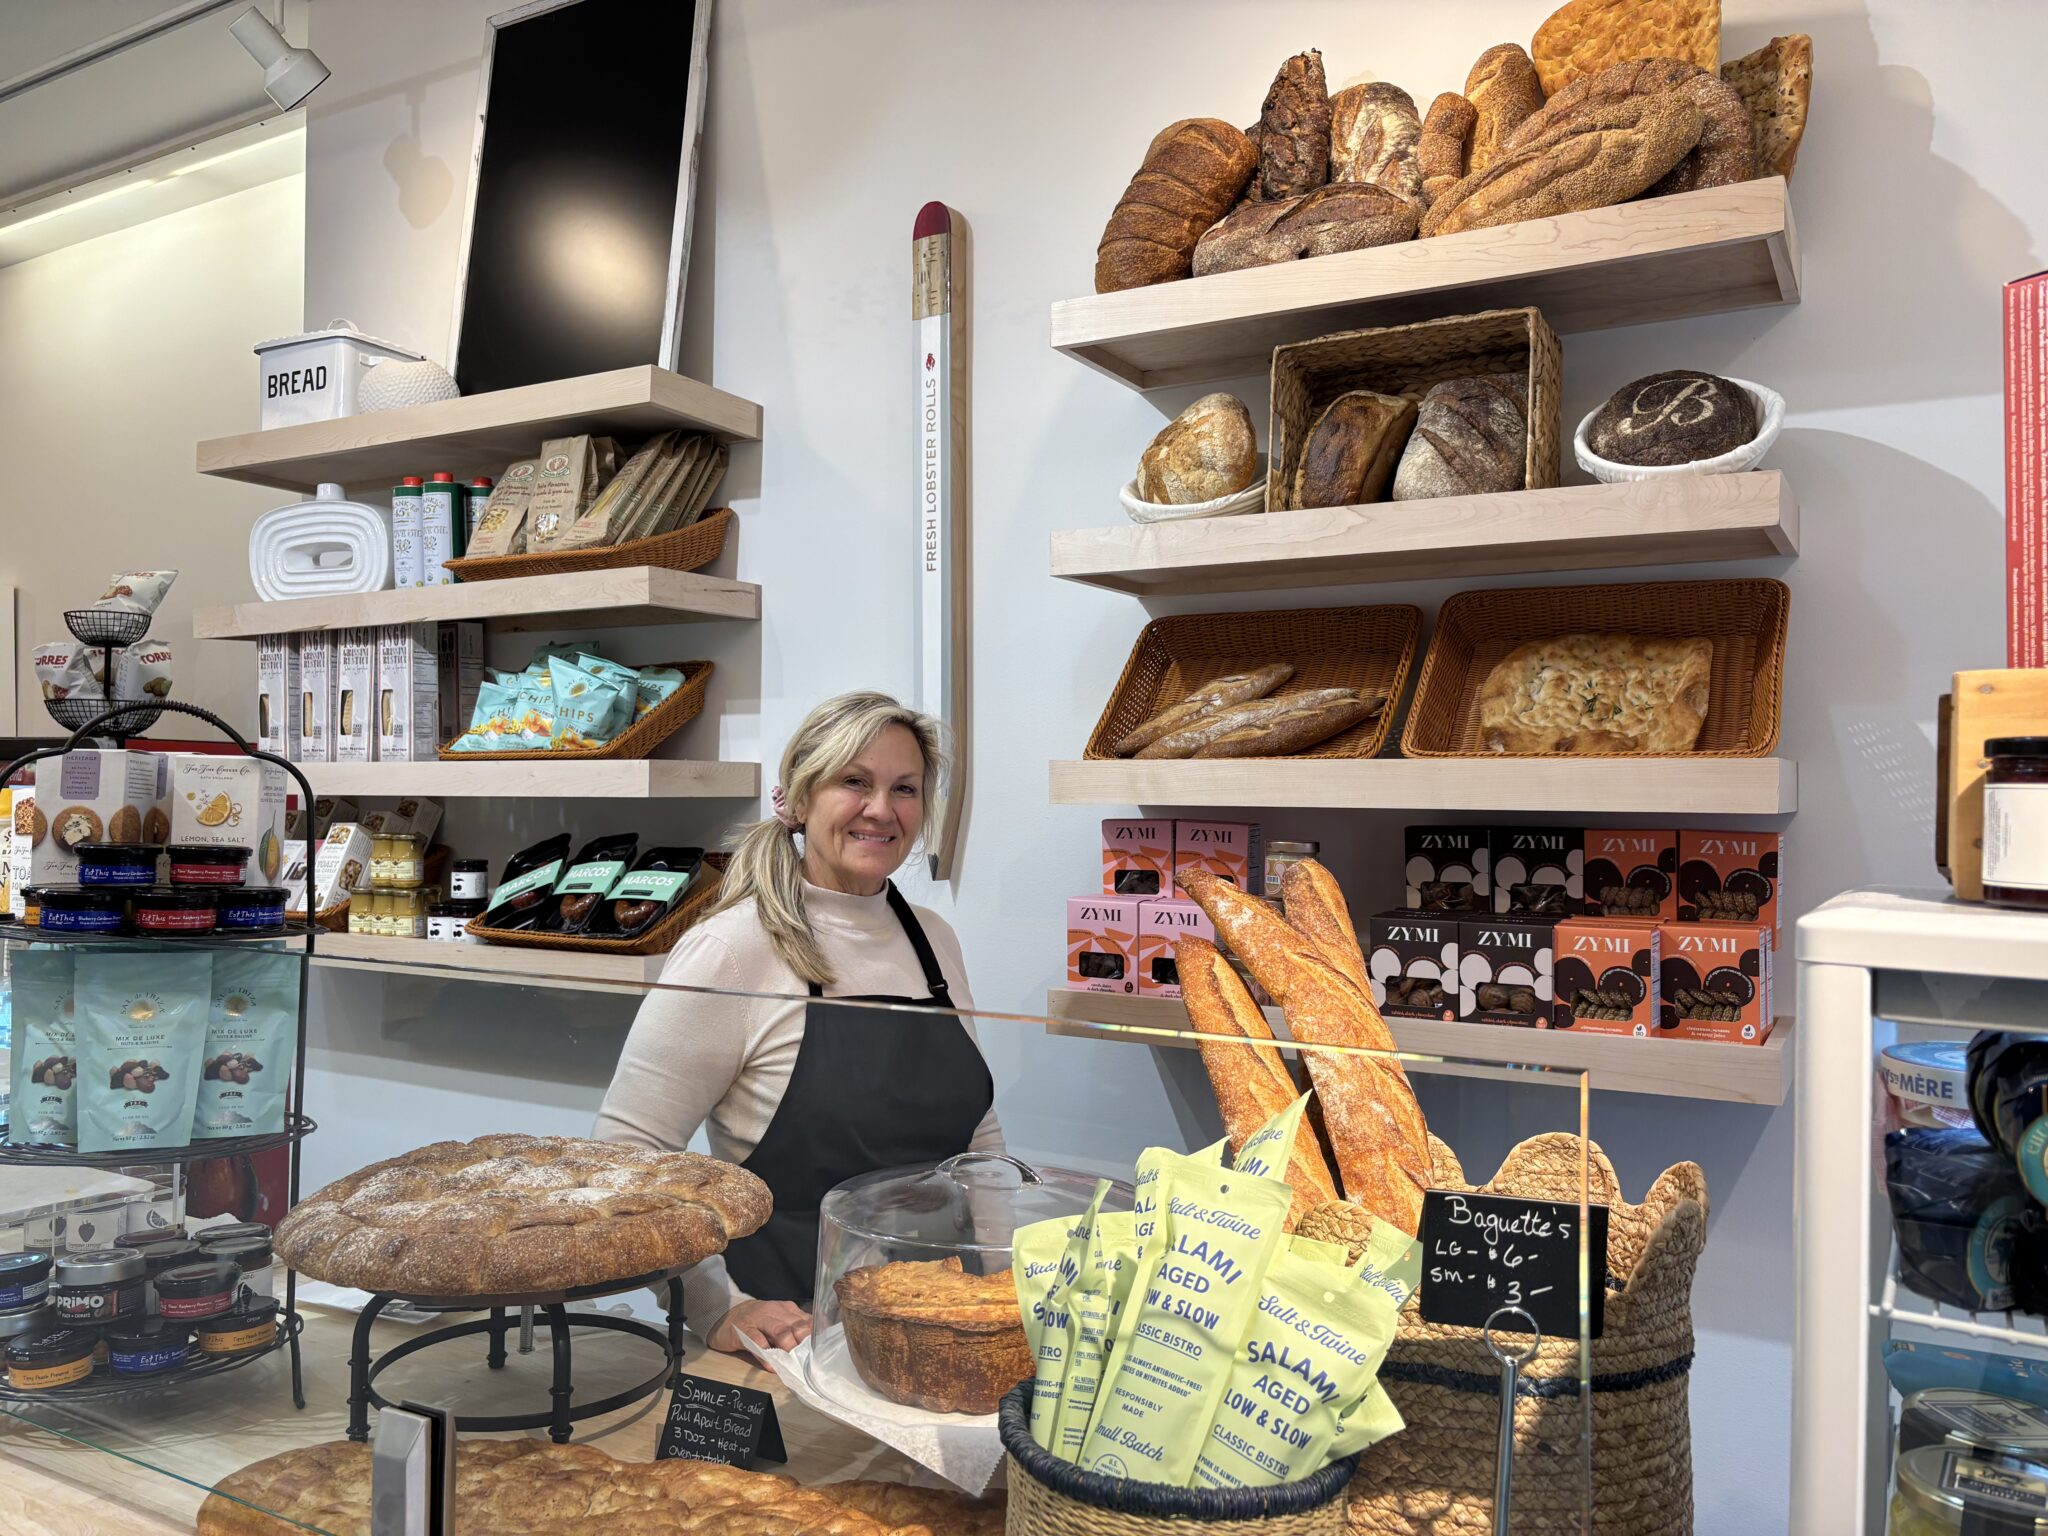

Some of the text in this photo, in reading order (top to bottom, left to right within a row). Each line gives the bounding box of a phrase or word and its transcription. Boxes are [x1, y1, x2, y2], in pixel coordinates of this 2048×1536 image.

[267, 365, 328, 399] BREAD
[925, 378, 937, 572] FRESH LOBSTER ROLLS
[519, 691, 553, 704] CHIP
[556, 705, 595, 723] HIPS
[1115, 826, 1157, 840] ZYMI
[1190, 828, 1233, 844] ZYMI
[1421, 835, 1470, 849] ZYMI
[1512, 835, 1565, 850] ZYMI
[1602, 837, 1656, 853] ZYMI
[1699, 839, 1758, 856] ZYMI
[497, 865, 553, 895] MARCOS
[567, 866, 613, 879] MARCOS
[622, 875, 676, 886] MARCOS
[1080, 906, 1122, 922] ZYMI
[1154, 911, 1199, 927] ZYMI
[1387, 926, 1440, 943] ZYMI
[1477, 931, 1533, 948] ZYMI
[1573, 936, 1630, 954] ZYMI
[1678, 936, 1737, 954] ZYMI
[1900, 1072, 1953, 1100] MÈRE
[1193, 1208, 1209, 1222] &
[1206, 1209, 1262, 1240] Twine
[1445, 1196, 1572, 1245] Baguette's
[1156, 1262, 1211, 1294] AGED
[1161, 1294, 1220, 1330] & SLOW
[1257, 1295, 1367, 1366] Salt & Twine
[1162, 1331, 1203, 1357] BISTRO
[1133, 1355, 1153, 1370] ALWAYS
[1247, 1340, 1341, 1405] SALAMI
[678, 1379, 727, 1406] SAMLE
[1143, 1371, 1168, 1389] NITRITES
[1114, 1387, 1163, 1413] RESPONSIBLY
[1252, 1374, 1310, 1415] AGED
[671, 1403, 753, 1438] Pull Apart Bread
[1121, 1403, 1145, 1418] MADE
[1223, 1388, 1313, 1450] LOW & SLOW
[673, 1426, 682, 1438] 3
[717, 1437, 739, 1452] Heat
[1120, 1430, 1164, 1462] Batch
[1213, 1423, 1290, 1476] CLASSIC BISTRO
[1200, 1456, 1214, 1470] PORK
[1219, 1466, 1243, 1487] ALWAYS
